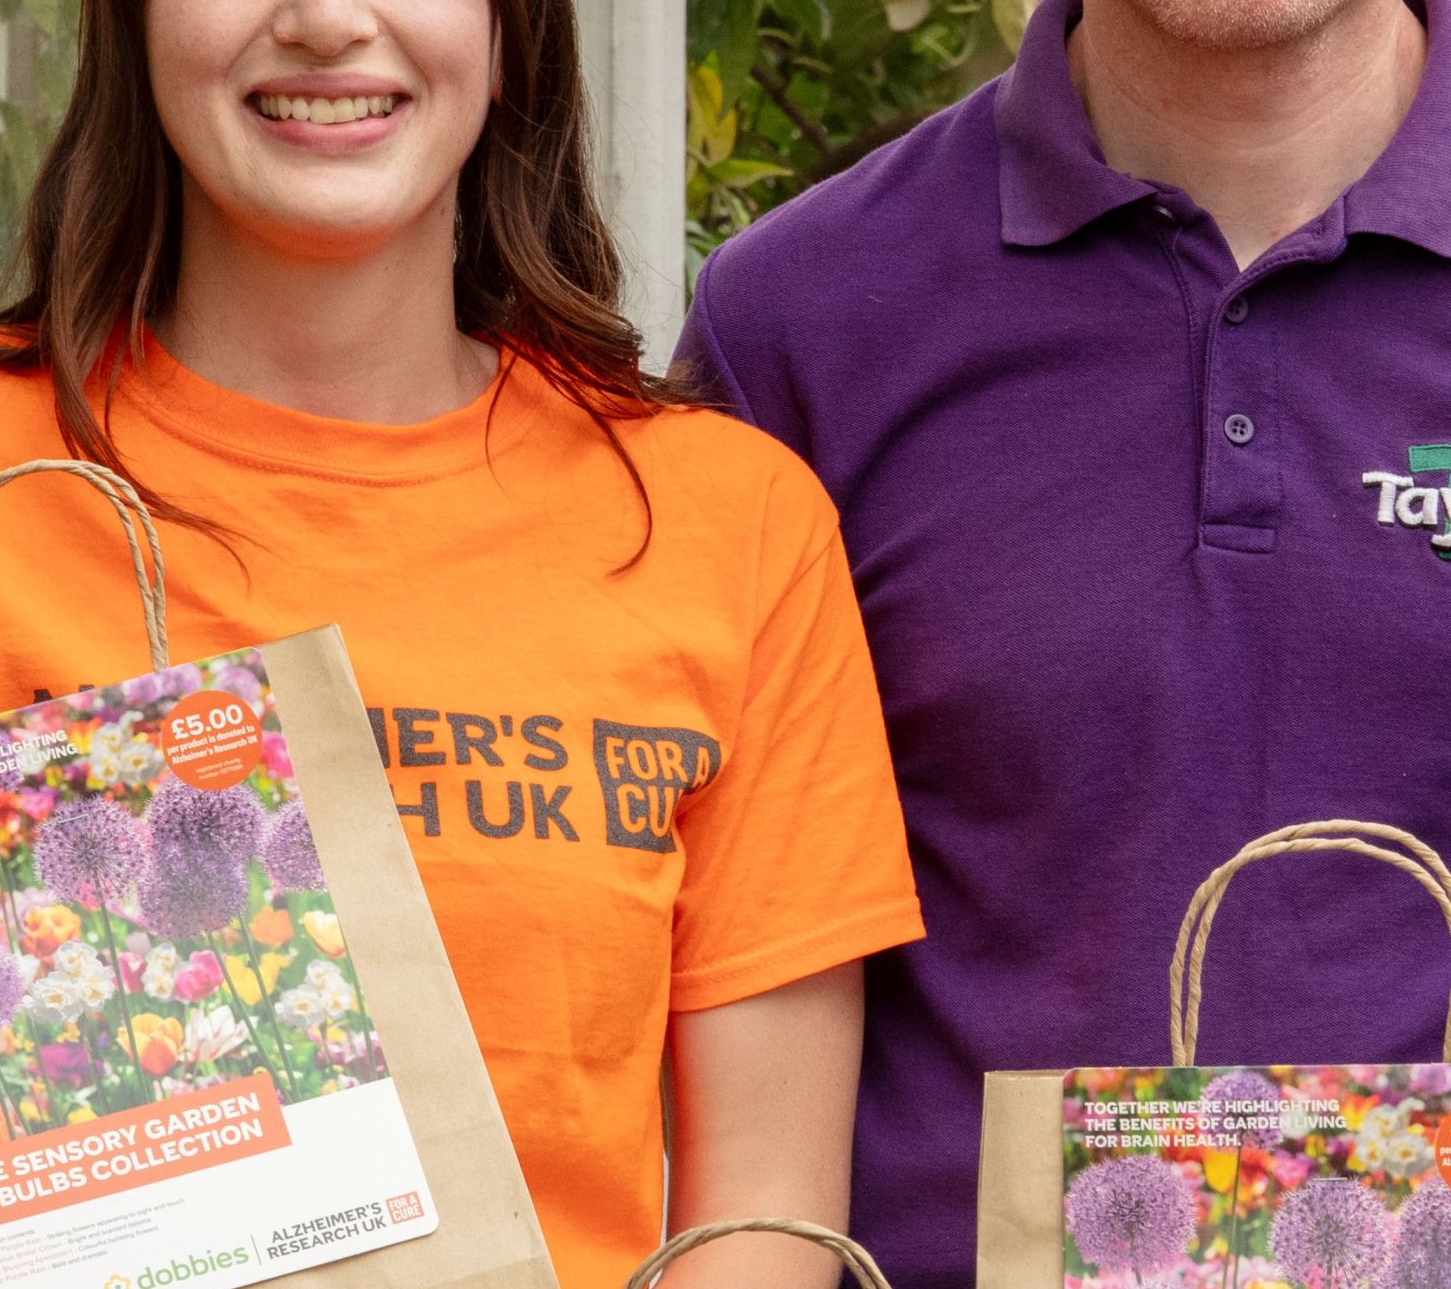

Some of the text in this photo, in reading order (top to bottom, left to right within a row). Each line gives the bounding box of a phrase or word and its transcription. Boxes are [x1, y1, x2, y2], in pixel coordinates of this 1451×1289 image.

[169, 702, 244, 741] £5.00
[30, 743, 78, 765] LIVING
[606, 736, 684, 782] FOR
[692, 746, 712, 790] A
[465, 779, 580, 843] UK
[1084, 1100, 1339, 1114] TOGETHER WE'RE HIGHLIGHTING
[1085, 1116, 1346, 1131] THE BENEFITS OF GARDEN LIVING
[10, 1123, 141, 1177] SENSORY
[142, 1091, 261, 1141] GARDEN
[89, 1117, 264, 1182] COLLECTION
[1085, 1134, 1240, 1147] FOR BRAIN HEALTH.
[388, 1194, 418, 1210] FOR A
[392, 1203, 422, 1221] CURE
[266, 1215, 387, 1259] RESEARCH UK
[269, 1201, 382, 1243] ALZHEIMER'S
